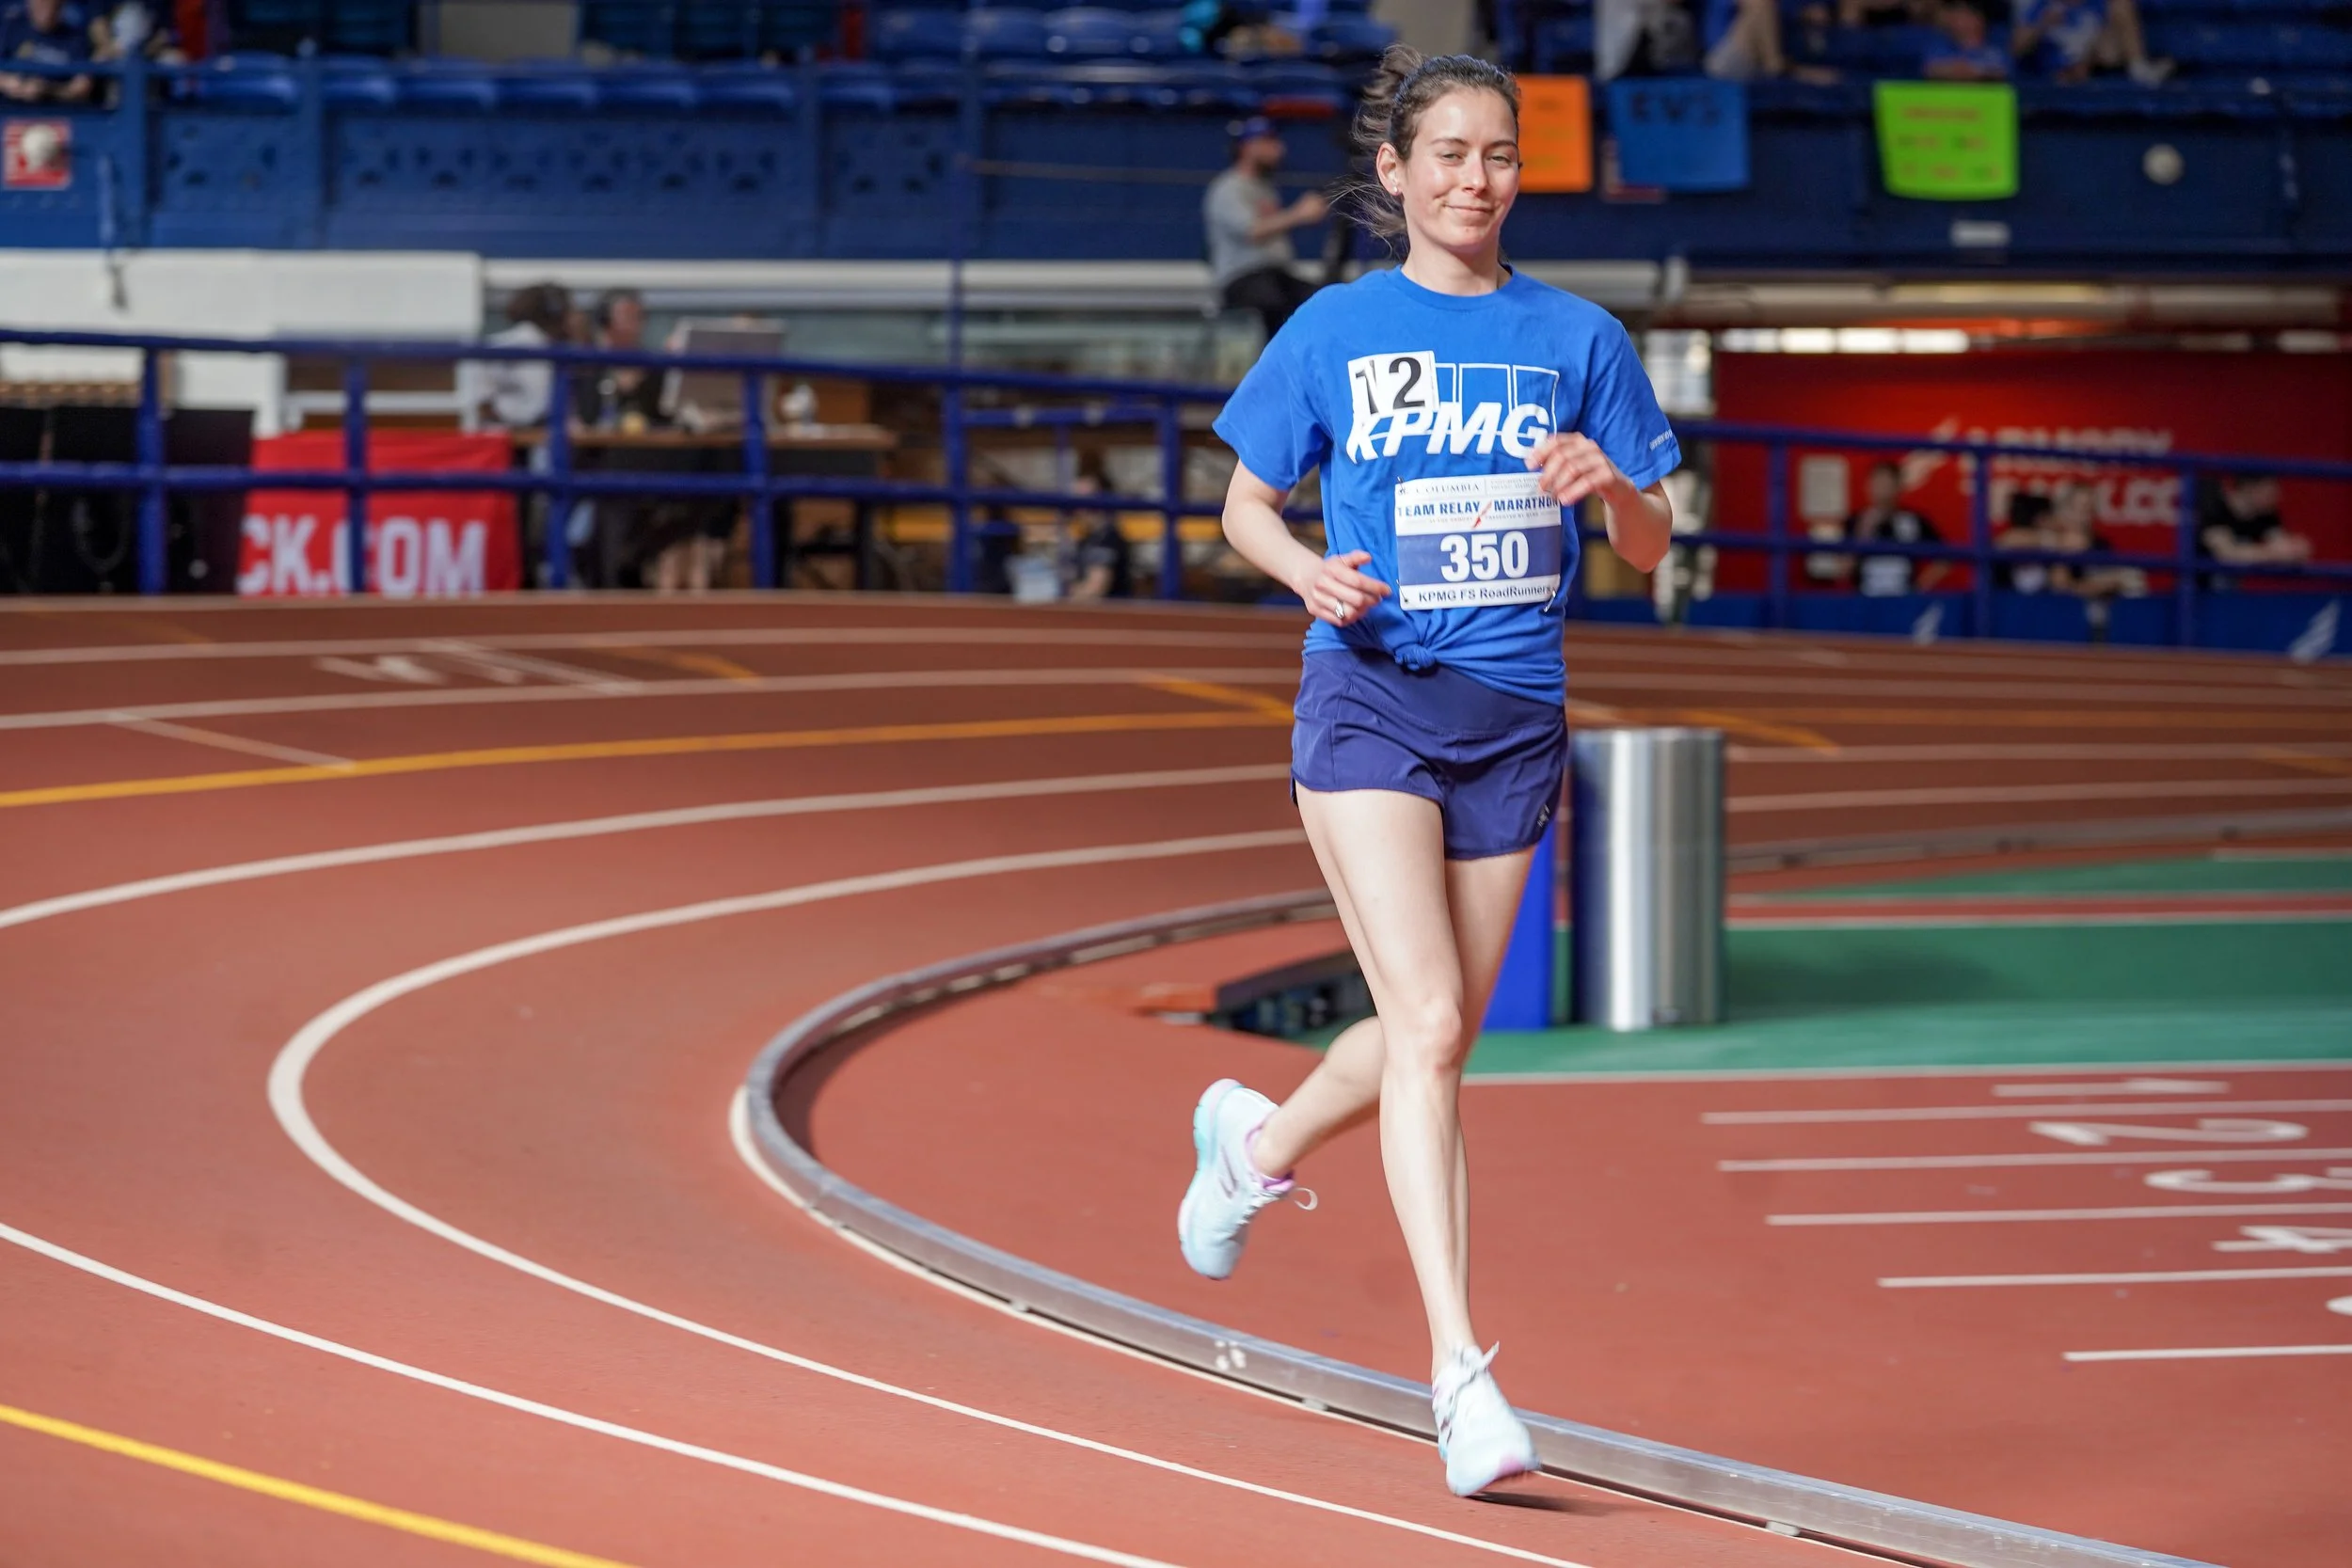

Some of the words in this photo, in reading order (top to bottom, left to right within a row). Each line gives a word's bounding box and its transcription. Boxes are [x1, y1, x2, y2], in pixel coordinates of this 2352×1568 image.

[1346, 402, 1550, 465] KPMG
[1398, 504, 1435, 517] TEAM
[1439, 500, 1481, 514] RELAY
[1494, 495, 1559, 512] MARATHON
[1440, 531, 1529, 582] 350
[1419, 591, 1456, 602] KPMG
[1460, 588, 1476, 600] FS
[1480, 584, 1551, 600] RoadRunners
